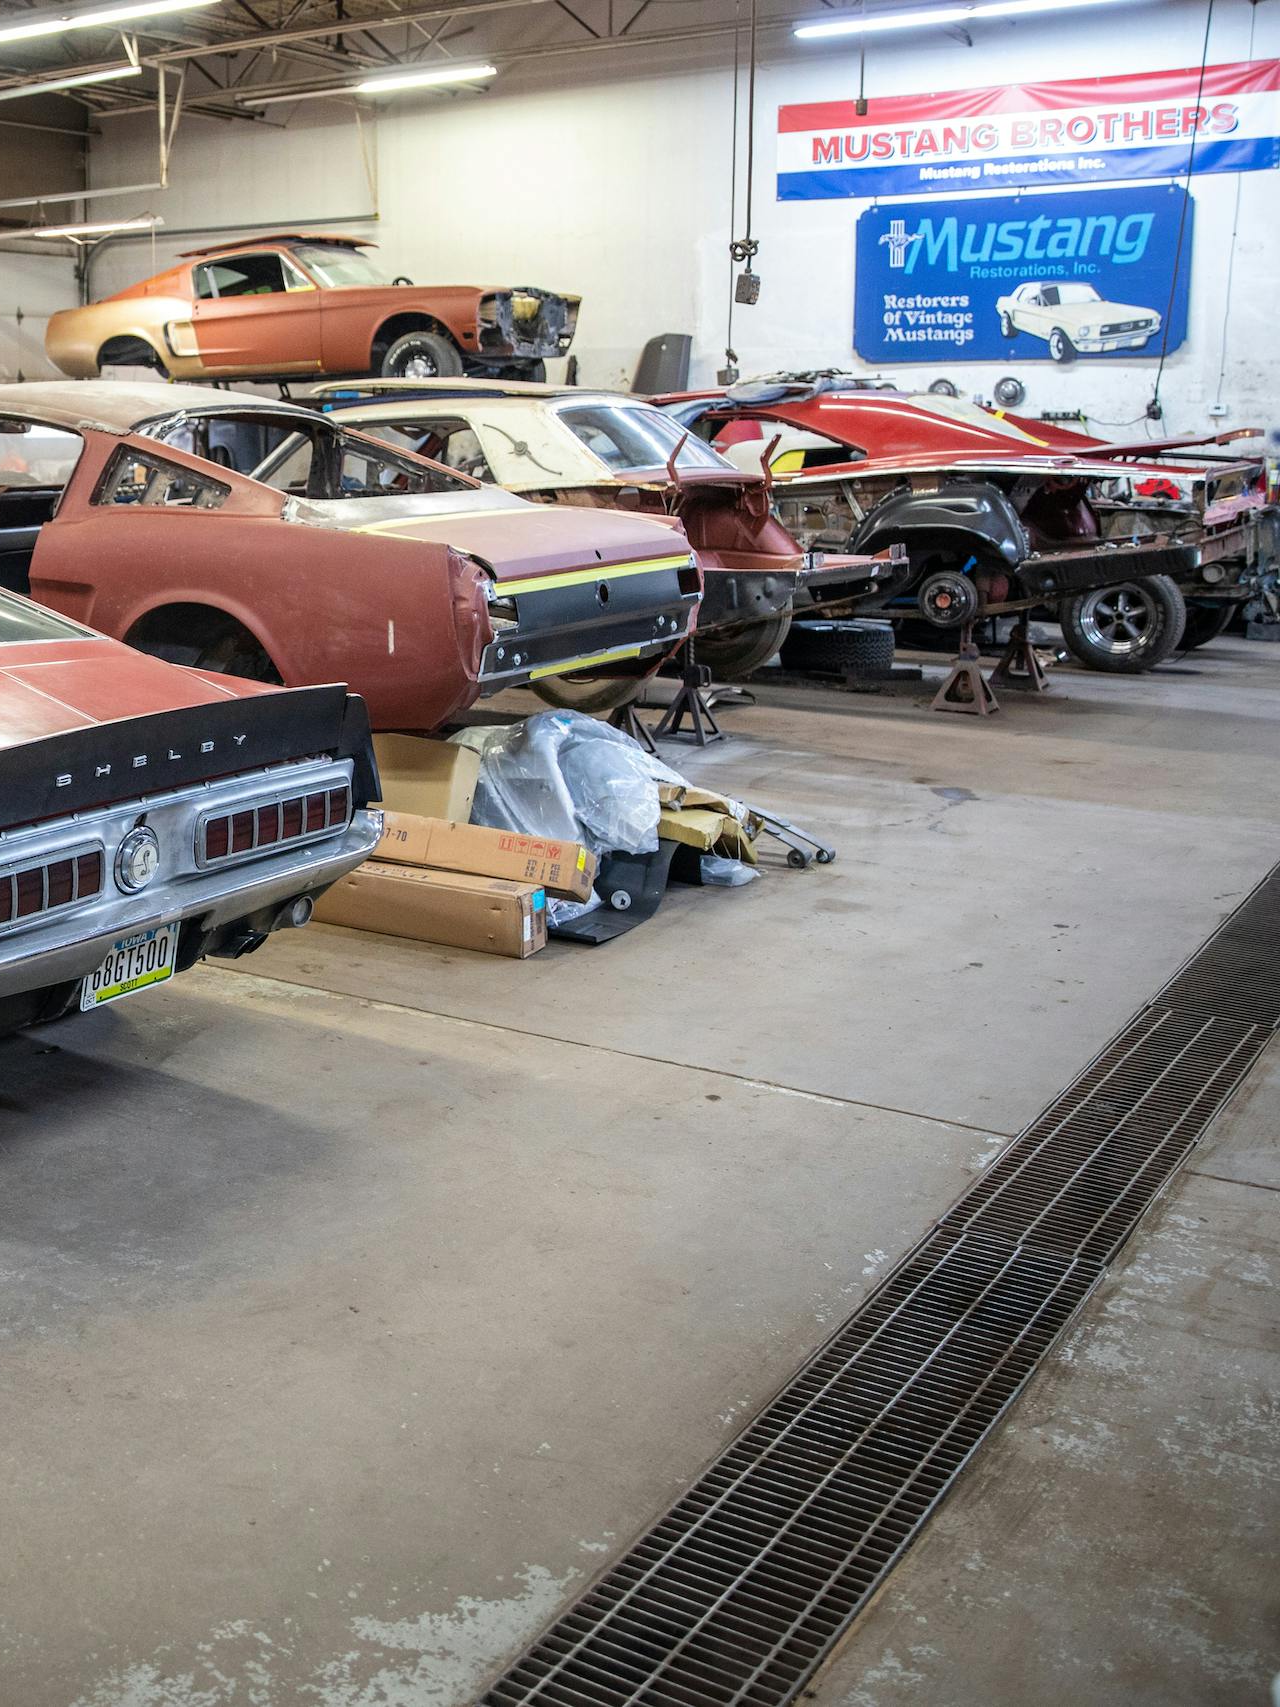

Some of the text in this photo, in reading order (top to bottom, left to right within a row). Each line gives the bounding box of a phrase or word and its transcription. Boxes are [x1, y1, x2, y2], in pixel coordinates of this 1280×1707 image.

[812, 102, 1240, 165] MUSTANG BROTHERS
[920, 156, 1106, 181] Mustang Restorations Inc.
[904, 212, 1156, 275] Mustang
[1073, 261, 1101, 274] Inc.
[883, 294, 970, 309] Restorers
[883, 310, 974, 329] Of Vintage
[882, 327, 975, 346] Mustangs
[56, 734, 247, 787] SHELBY
[121, 933, 147, 948] IOWA
[120, 978, 138, 991] SCOTT
